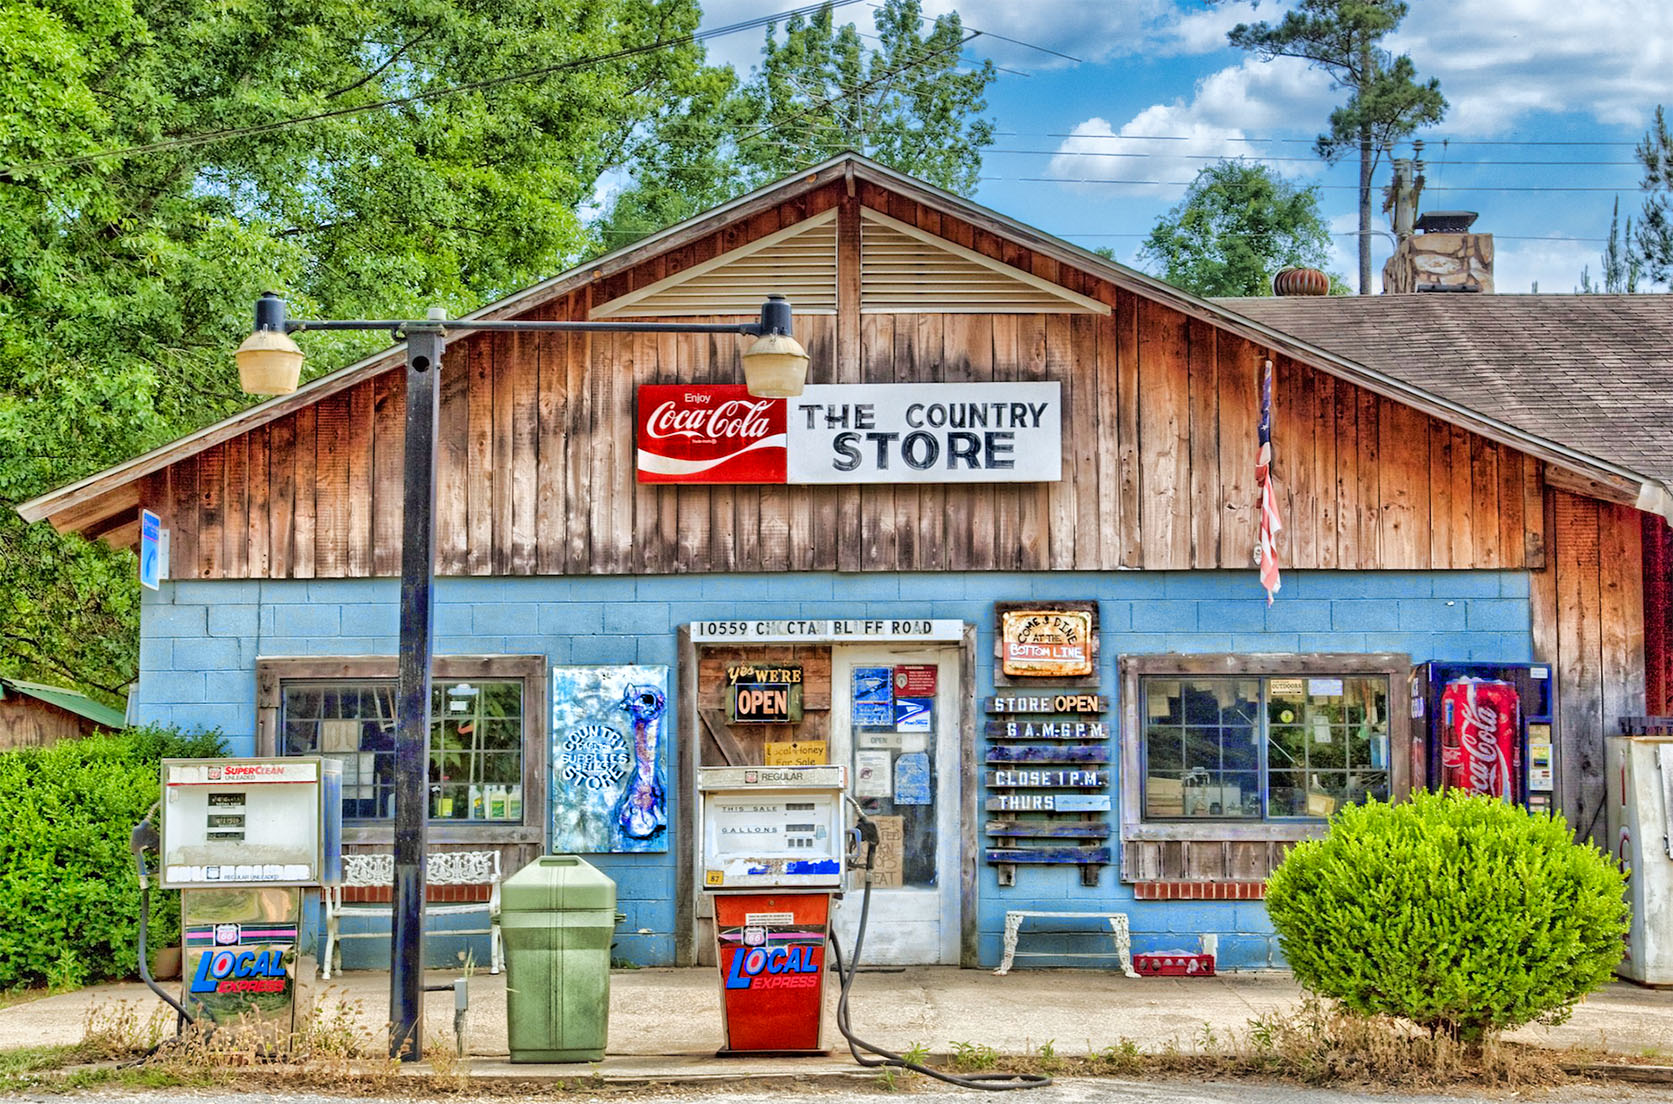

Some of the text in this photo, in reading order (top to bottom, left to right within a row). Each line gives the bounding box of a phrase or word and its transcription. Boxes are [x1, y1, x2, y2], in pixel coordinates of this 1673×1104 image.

[684, 393, 711, 404] Enjoy
[646, 400, 776, 439] Coca-Cola
[798, 402, 1049, 430] THE COUNTRY
[832, 431, 1016, 471] STORE
[700, 621, 748, 635] 10559
[833, 621, 884, 635] BLFF
[1017, 617, 1040, 644] COME
[1053, 617, 1078, 645] DINE
[1032, 634, 1062, 642] AT THE
[1010, 643, 1084, 657] BOTTOM LINE
[738, 689, 787, 715] OPEN
[994, 695, 1099, 712] STORE OPEN
[563, 725, 628, 751] COUNTRY
[561, 752, 630, 764] SUPPLIES
[563, 764, 627, 791] STORE
[762, 772, 803, 781] REGULAR
[995, 771, 1051, 785] CLOSE
[998, 795, 1054, 810] THURS
[190, 951, 286, 993] LOCAL
[726, 946, 818, 989] LOCAL
[217, 979, 286, 993] EXPRESS
[752, 975, 818, 990] EXPRESS
